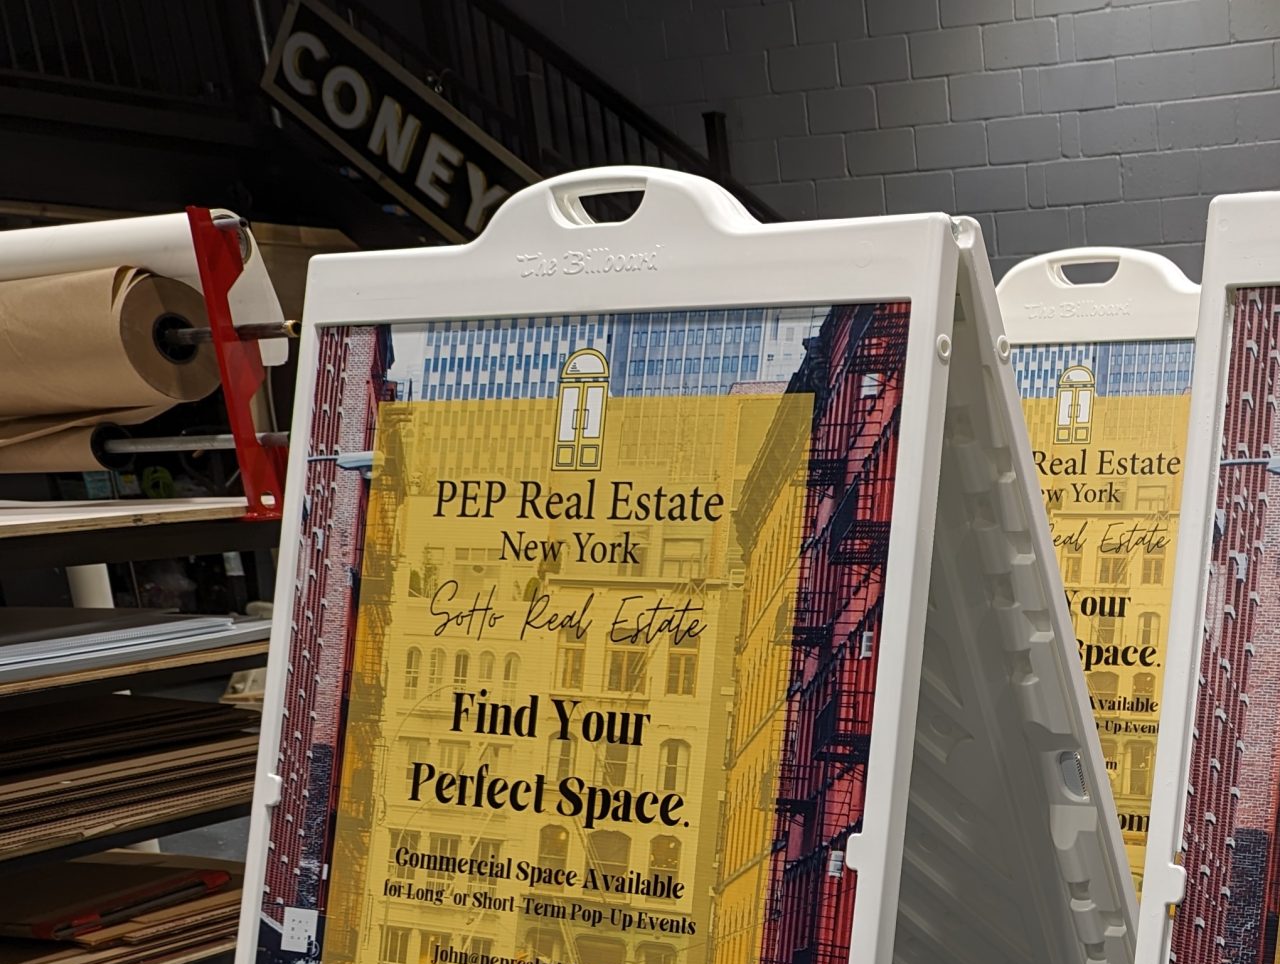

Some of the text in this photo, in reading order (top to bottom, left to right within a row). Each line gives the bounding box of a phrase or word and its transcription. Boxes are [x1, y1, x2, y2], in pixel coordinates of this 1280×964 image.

[283, 31, 510, 233] CONEY
[1032, 448, 1181, 476] Real Estate
[433, 479, 724, 523] PEP Real Estate
[1071, 482, 1121, 503] York
[499, 531, 641, 564] New York
[1100, 522, 1171, 554] Estate
[430, 580, 708, 645] SoHo Real Estate
[450, 689, 651, 746] Find Your
[408, 761, 690, 829] Perfect Space.
[395, 846, 685, 899] Commercial Space Available
[383, 878, 405, 897] for
[453, 891, 470, 906] or
[570, 904, 633, 931] Pop-Up
[636, 912, 696, 935] Events
